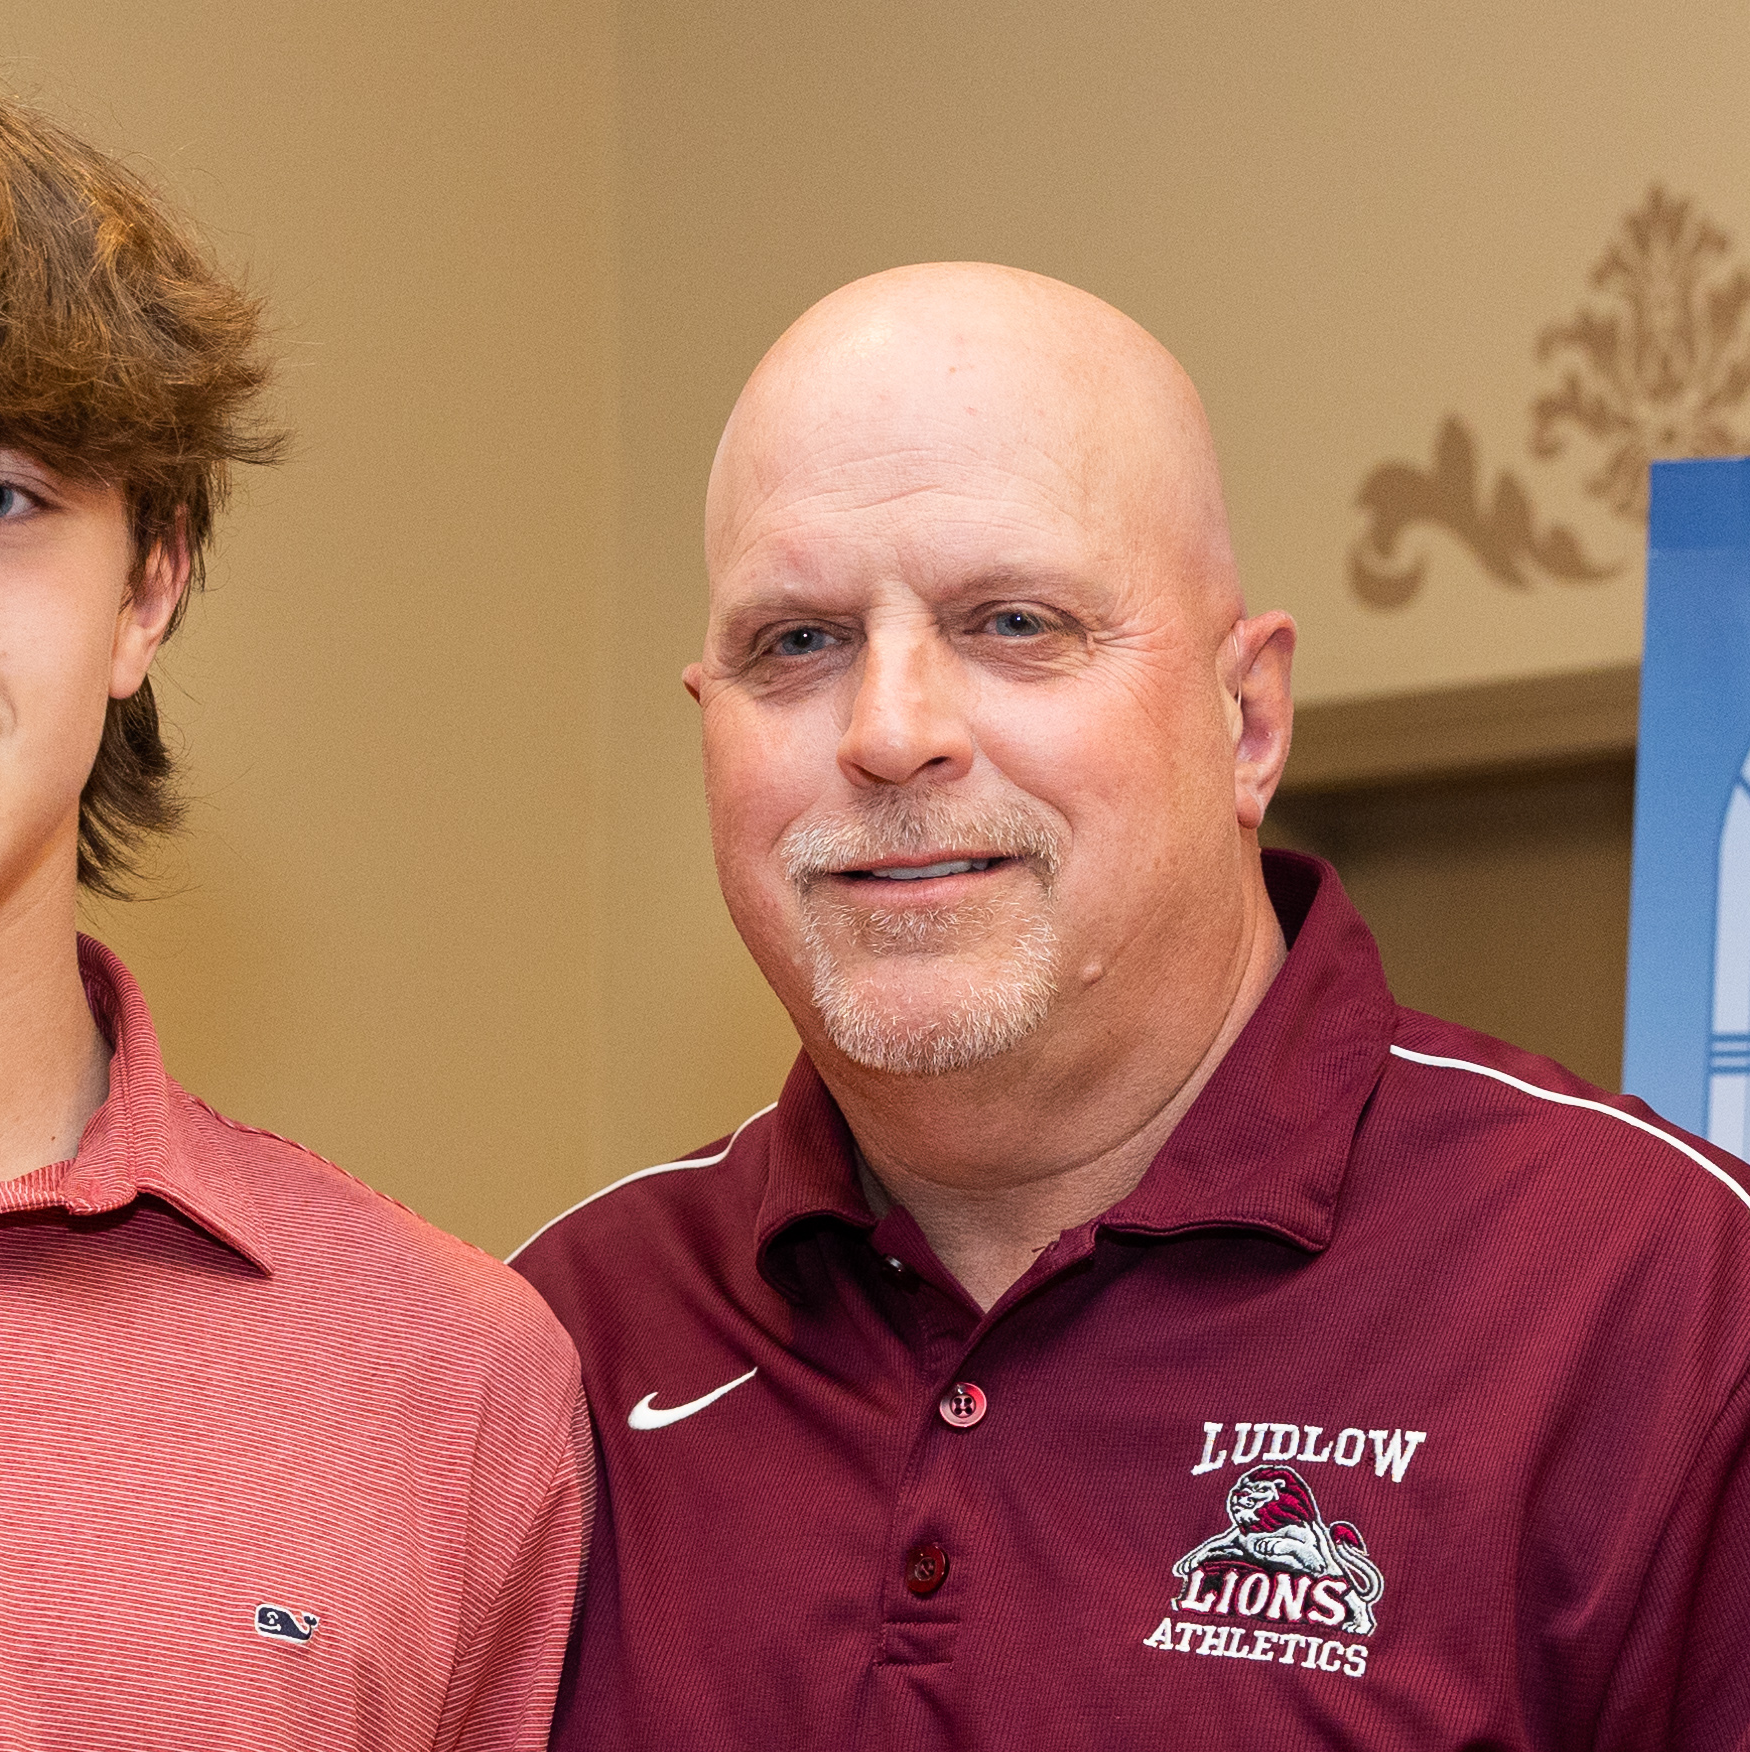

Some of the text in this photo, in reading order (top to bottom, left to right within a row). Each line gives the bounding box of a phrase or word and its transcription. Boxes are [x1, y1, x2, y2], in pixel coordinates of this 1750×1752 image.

[1191, 1422, 1426, 1484] LUDLOW
[1180, 1569, 1349, 1626] LIONS
[1143, 1617, 1369, 1677] ATHLETICS
